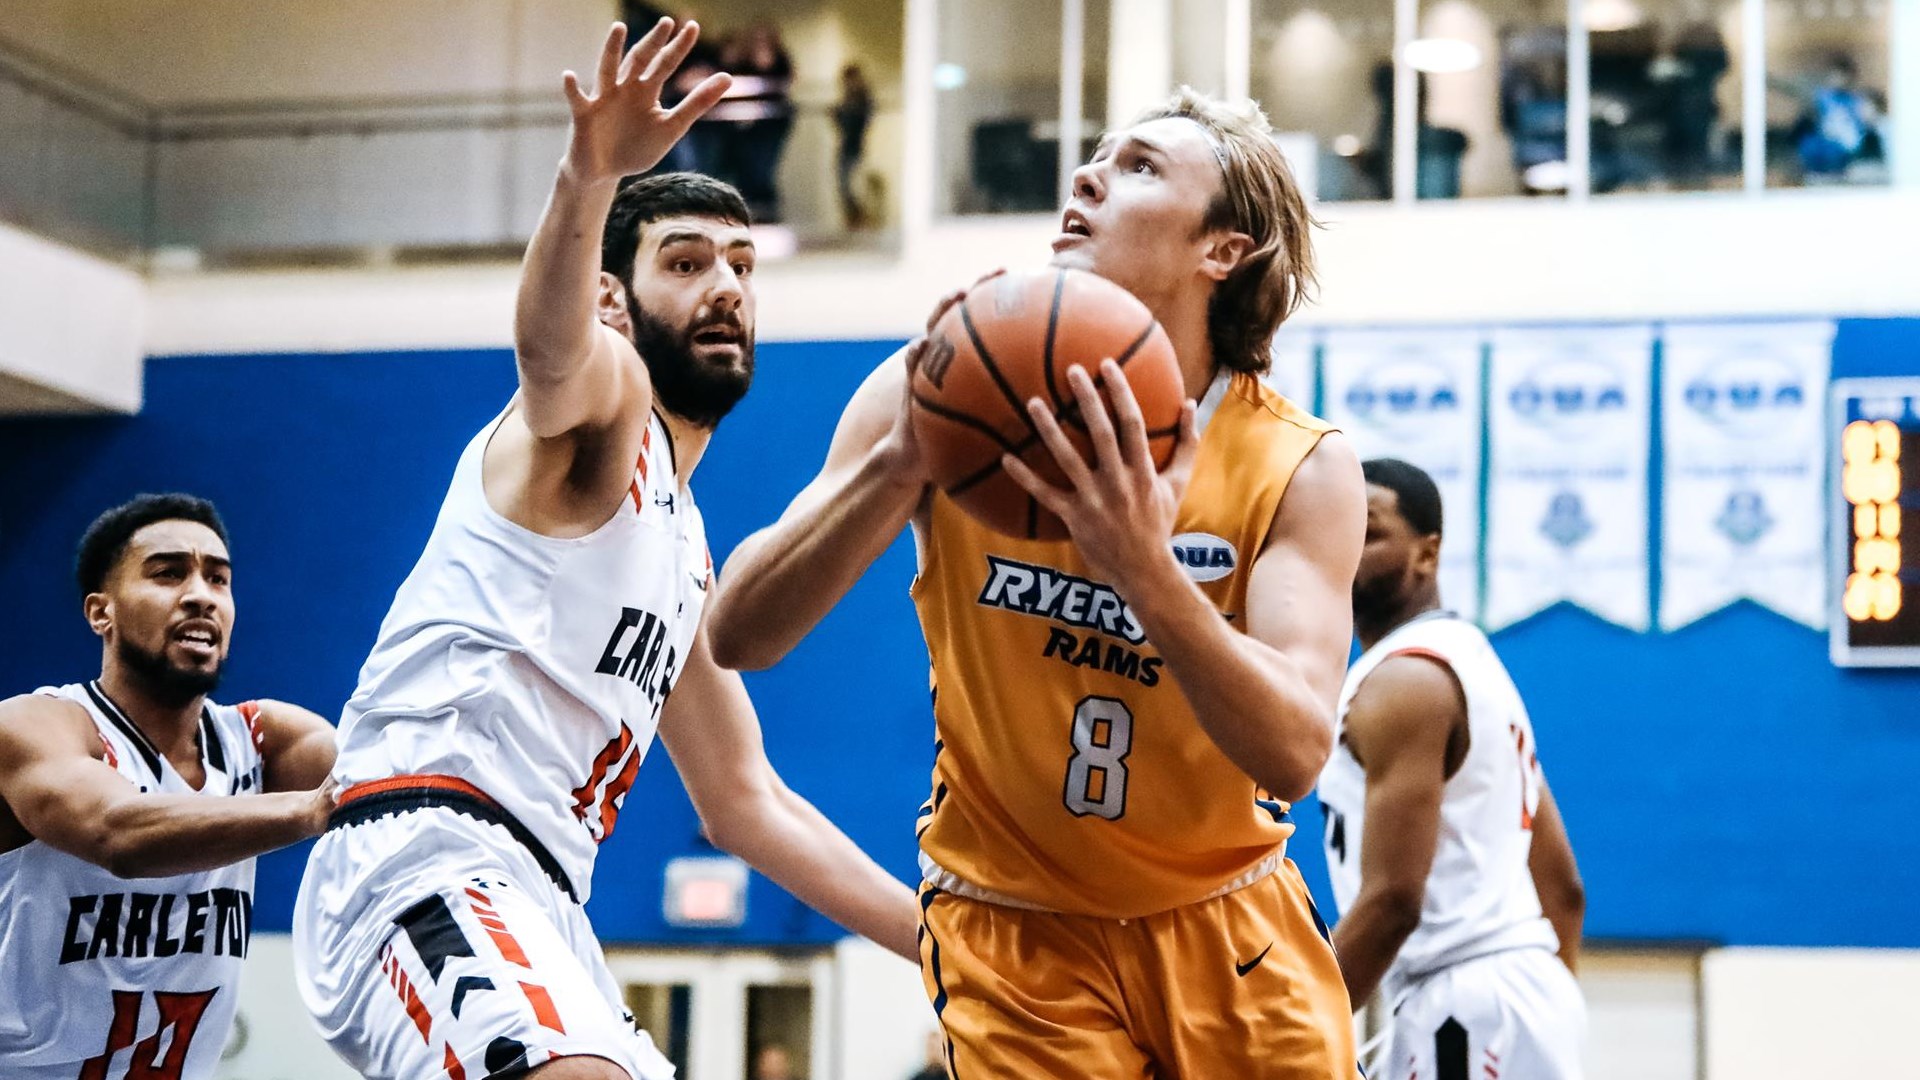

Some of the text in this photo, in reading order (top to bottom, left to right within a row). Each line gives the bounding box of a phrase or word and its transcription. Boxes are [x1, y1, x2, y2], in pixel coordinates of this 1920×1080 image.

[594, 606, 676, 719] CARLE
[1043, 626, 1163, 687] RAMS
[1063, 694, 1133, 821] 8
